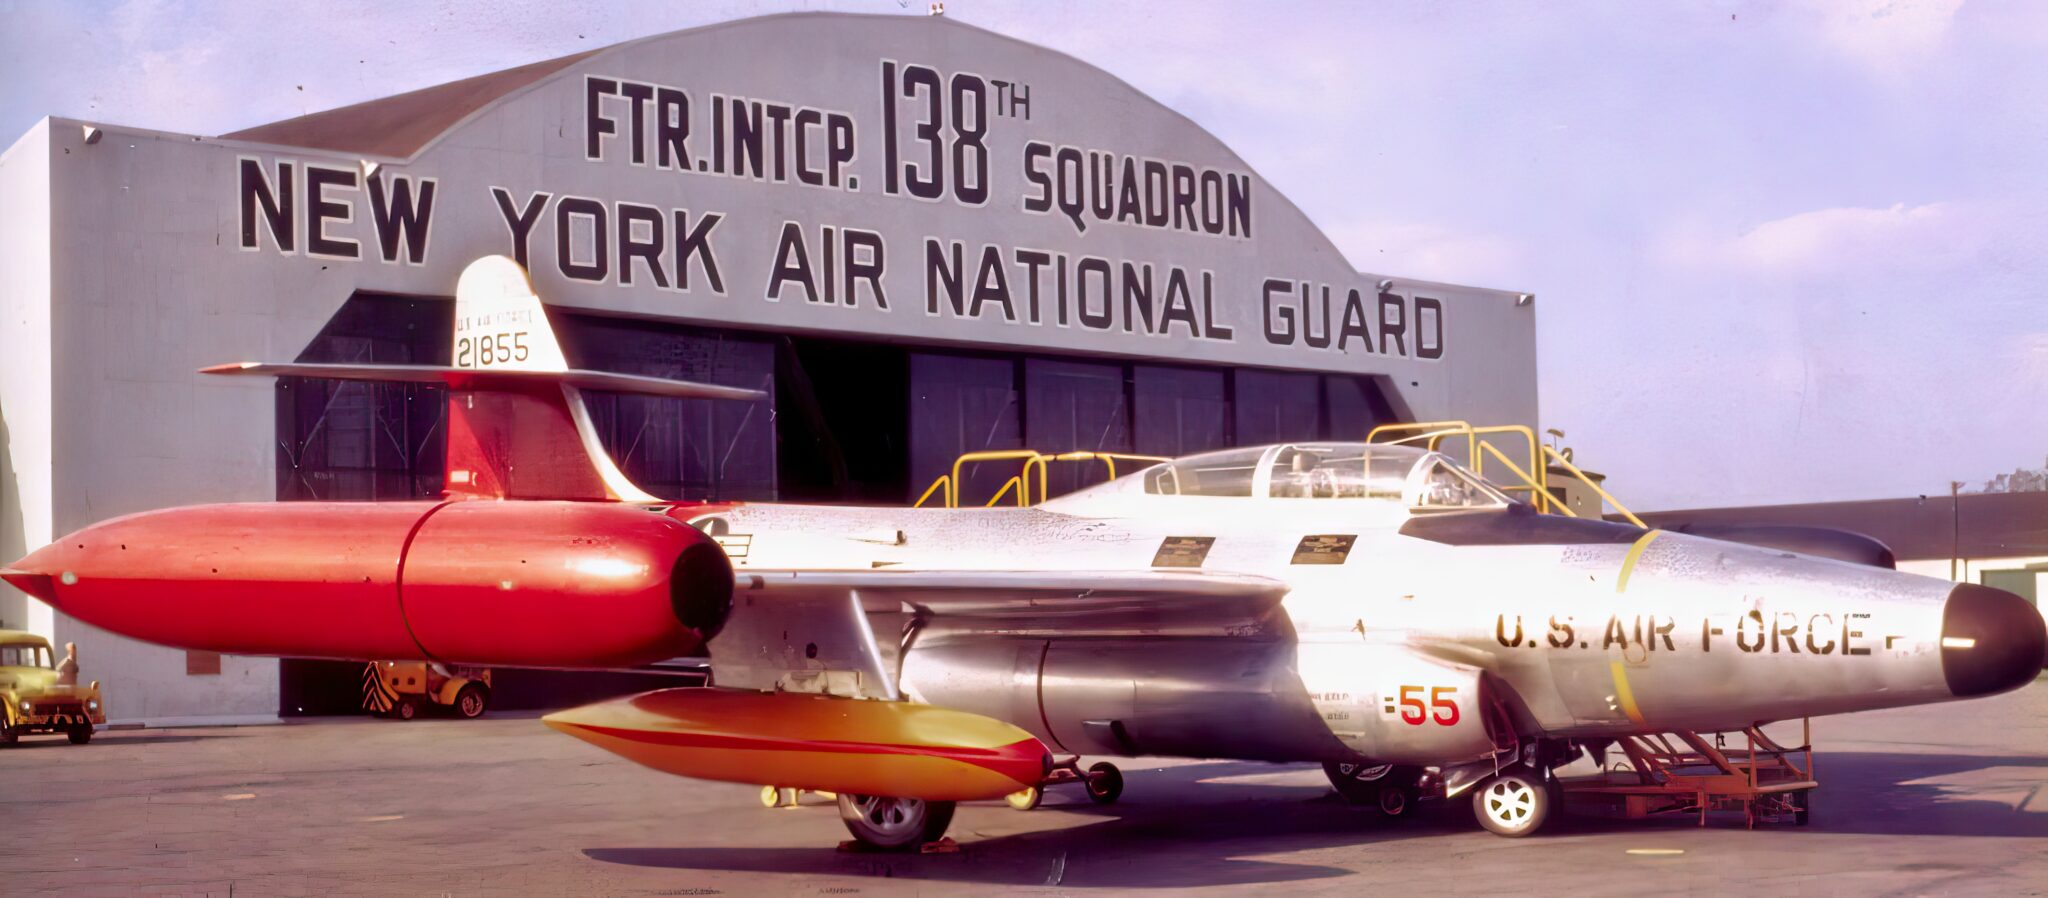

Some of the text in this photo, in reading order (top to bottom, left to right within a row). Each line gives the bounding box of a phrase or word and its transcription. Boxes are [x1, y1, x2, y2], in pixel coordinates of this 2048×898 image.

[1023, 141, 1252, 239] SQUADRON
[239, 157, 1446, 361] NEW YORK AIR NATIONAL GUARD
[458, 331, 529, 368] 21855
[1603, 613, 1676, 653] AIR
[1701, 610, 1872, 656] FORCE
